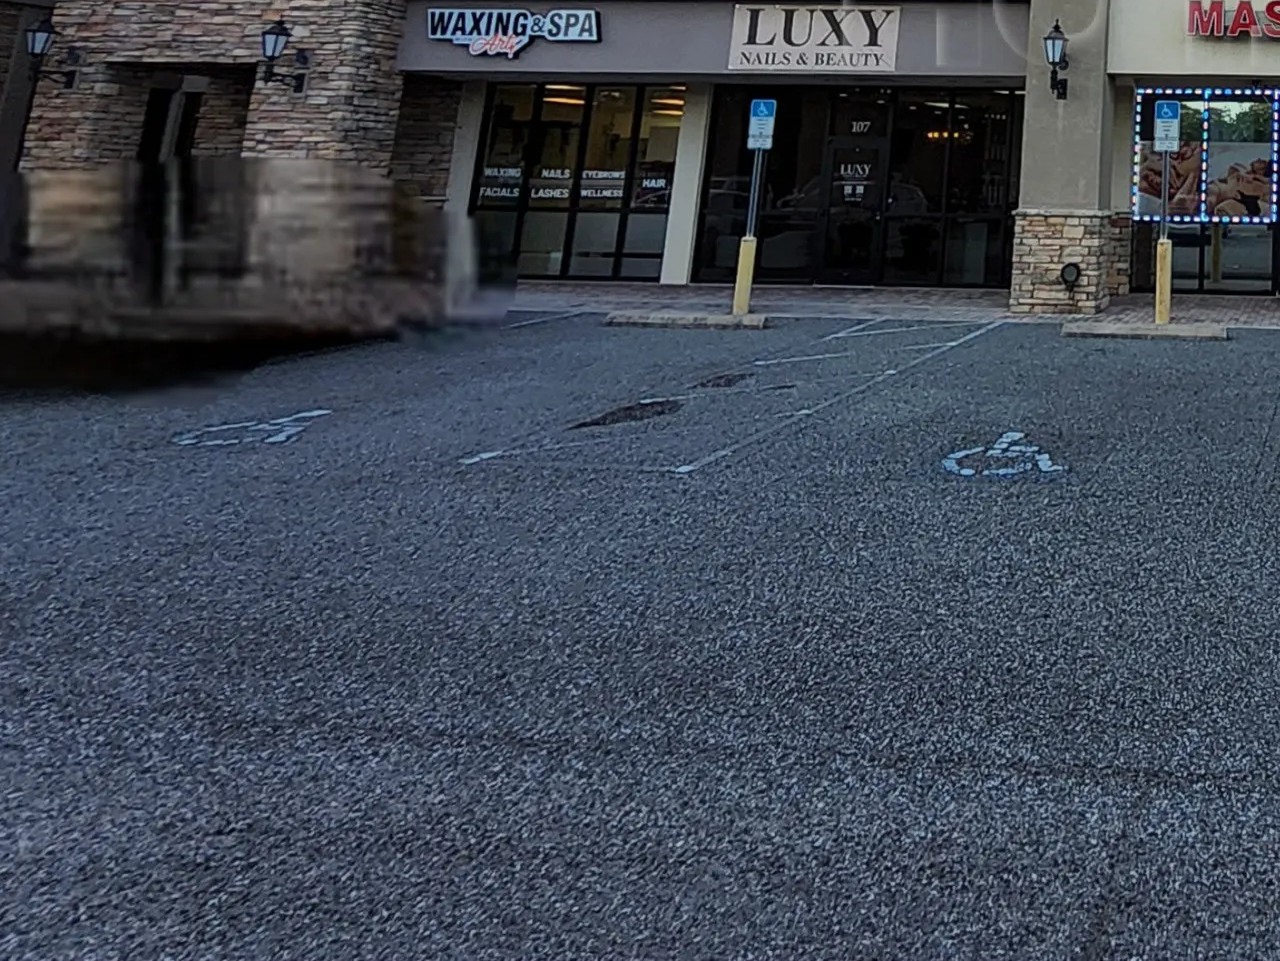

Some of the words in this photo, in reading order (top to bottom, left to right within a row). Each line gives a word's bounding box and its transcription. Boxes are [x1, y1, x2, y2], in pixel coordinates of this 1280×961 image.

[430, 11, 528, 36] WAXING
[548, 12, 594, 37] SPA
[742, 8, 894, 47] LUXY
[740, 52, 791, 66] NAILS
[796, 52, 809, 66] &
[814, 52, 885, 67] BEAUTY
[851, 121, 872, 133] 107
[484, 167, 521, 178] WAXING
[541, 168, 571, 179] NAILS
[840, 163, 872, 175] LUXY
[642, 178, 666, 188] HAIR
[479, 187, 520, 197] FACIALS
[531, 188, 570, 198] LASHES
[580, 189, 624, 198] WELLNESS
